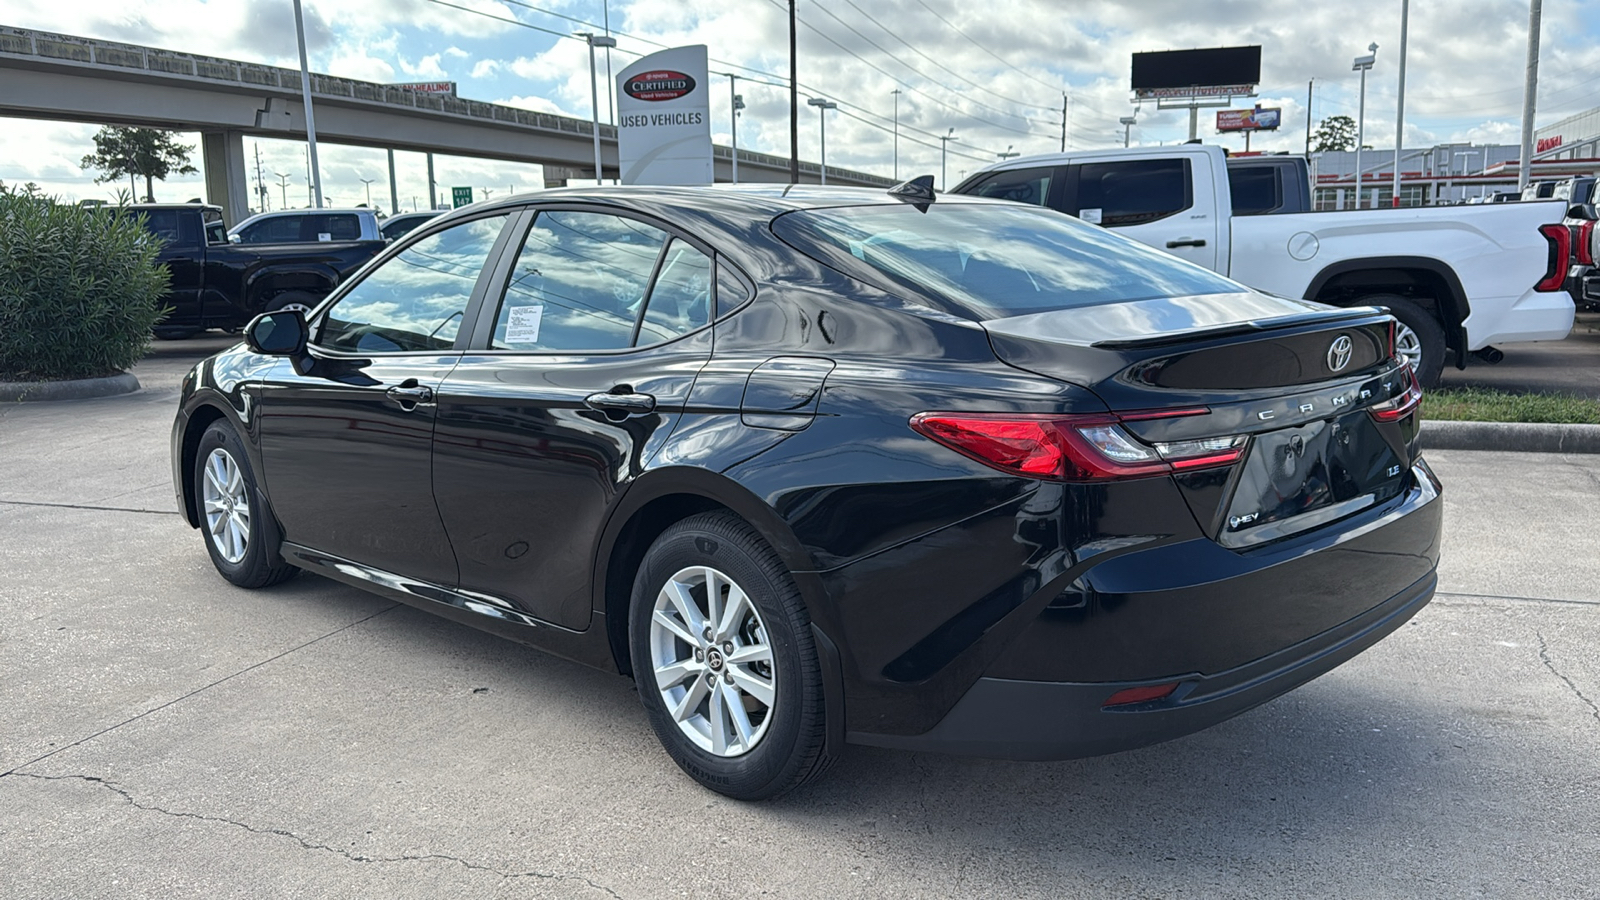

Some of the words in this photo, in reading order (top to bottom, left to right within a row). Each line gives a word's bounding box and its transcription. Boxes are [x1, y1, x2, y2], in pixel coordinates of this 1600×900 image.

[631, 80, 687, 92] CERTIFIED
[621, 115, 648, 128] USED
[650, 112, 702, 126] VEHICLES
[456, 198, 470, 206] 147
[1258, 382, 1393, 420] CAMRY
[1387, 464, 1400, 478] LE
[1237, 512, 1259, 525] HEV
